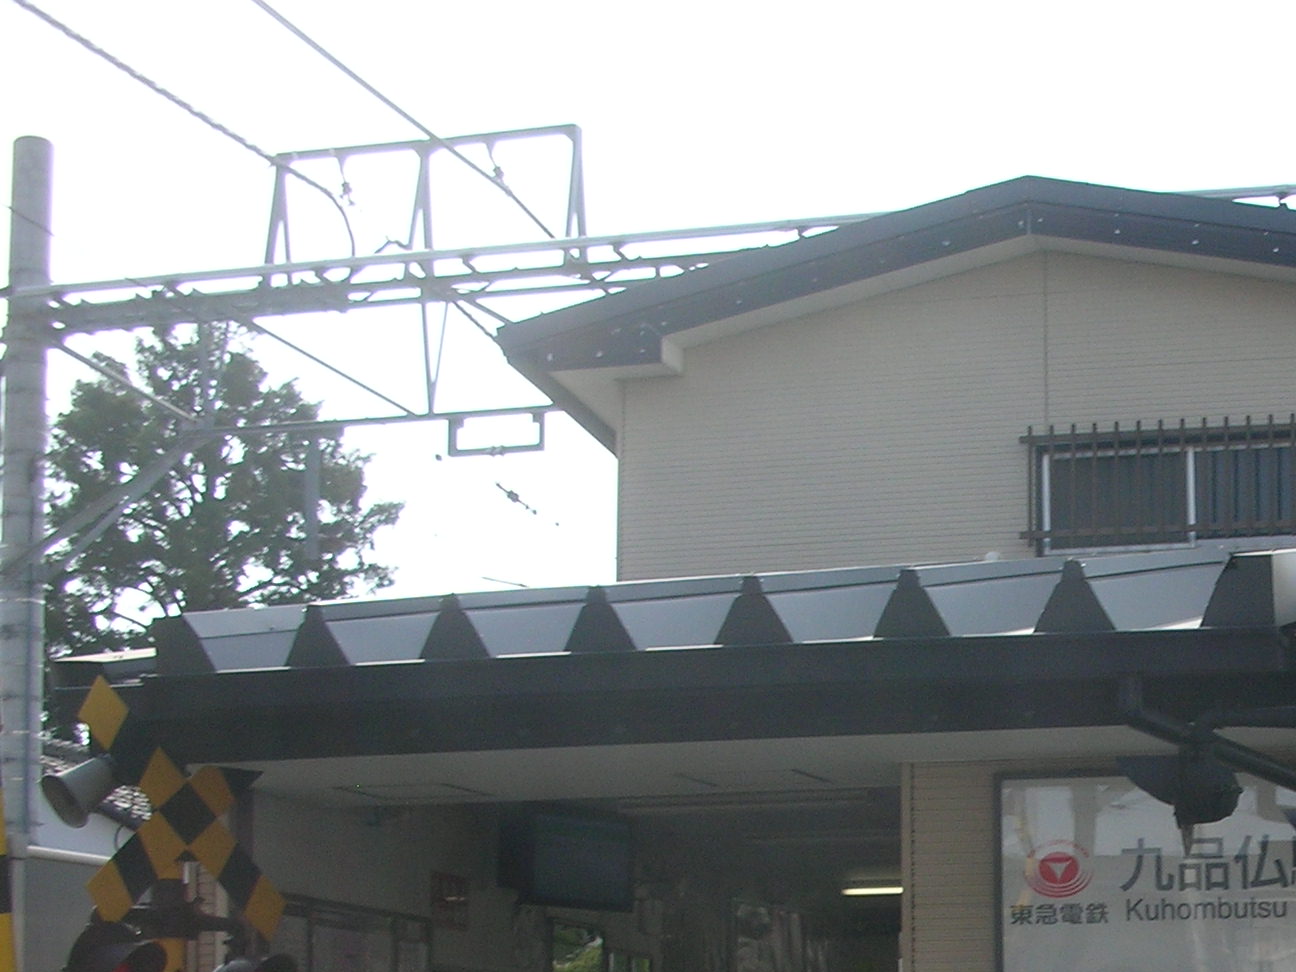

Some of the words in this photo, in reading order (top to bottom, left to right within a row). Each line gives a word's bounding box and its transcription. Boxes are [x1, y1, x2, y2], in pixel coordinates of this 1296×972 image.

[1009, 903, 1110, 925] 東急電鉄
[1126, 896, 1288, 923] Kuhombutsu
